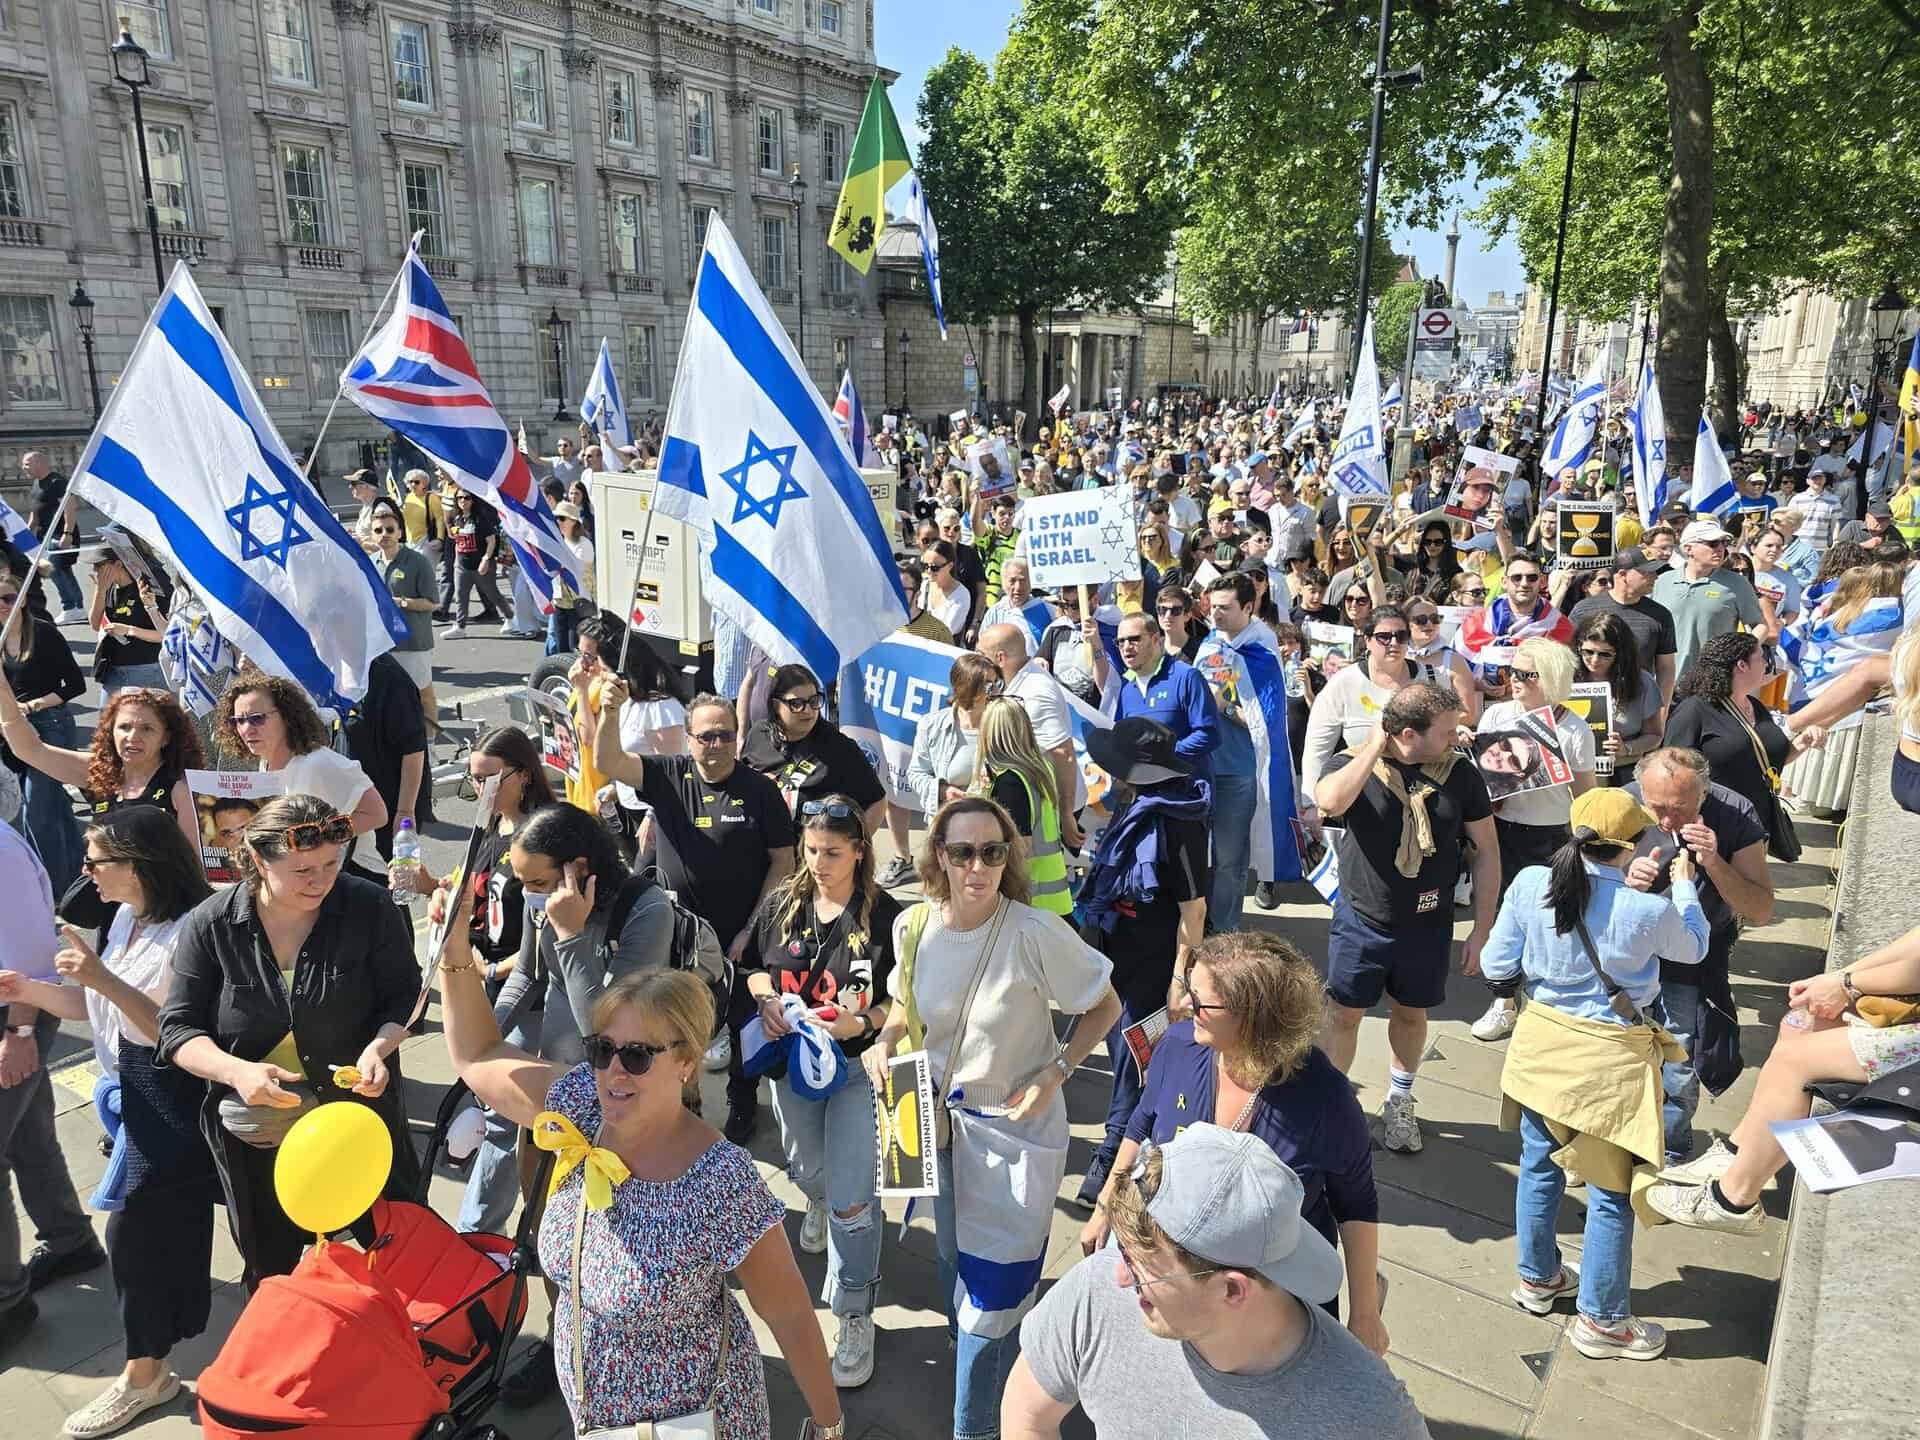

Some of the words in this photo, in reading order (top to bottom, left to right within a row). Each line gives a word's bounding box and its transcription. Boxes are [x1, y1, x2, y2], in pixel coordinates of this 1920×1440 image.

[1028, 517, 1034, 532] I
[1040, 510, 1099, 530] STAND
[1030, 531, 1073, 549] WITH
[1031, 548, 1096, 567] ISRAEL
[864, 663, 949, 721] #LET
[1593, 686, 1607, 694] OUT
[918, 1059, 926, 1087] TIME
[920, 1088, 928, 1099] IS
[921, 1102, 932, 1158] RUNNING
[925, 1161, 934, 1188] OUT
